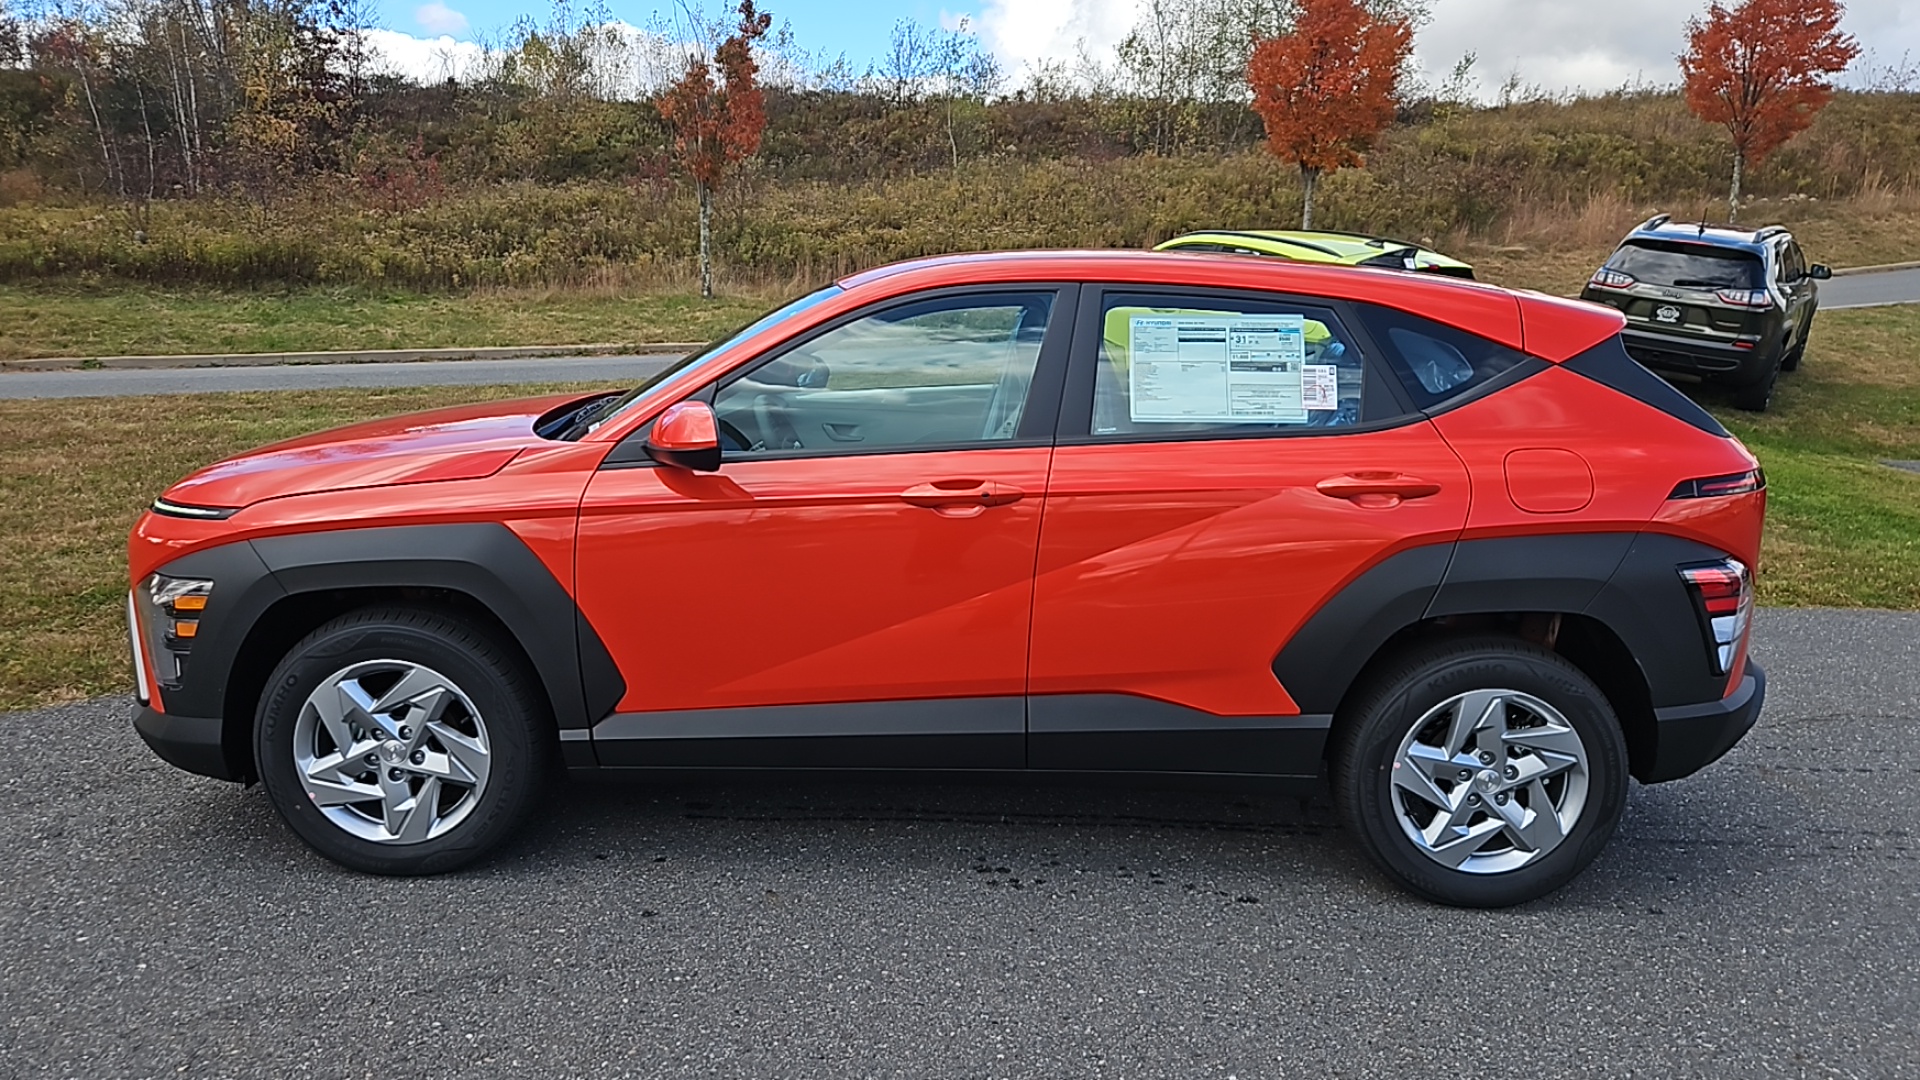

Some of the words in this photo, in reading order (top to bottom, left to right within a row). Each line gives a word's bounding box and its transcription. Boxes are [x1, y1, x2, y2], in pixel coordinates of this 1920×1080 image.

[265, 673, 298, 742] KUMHO
[1427, 664, 1507, 692] KUMHO
[488, 756, 515, 823] SOLUS
